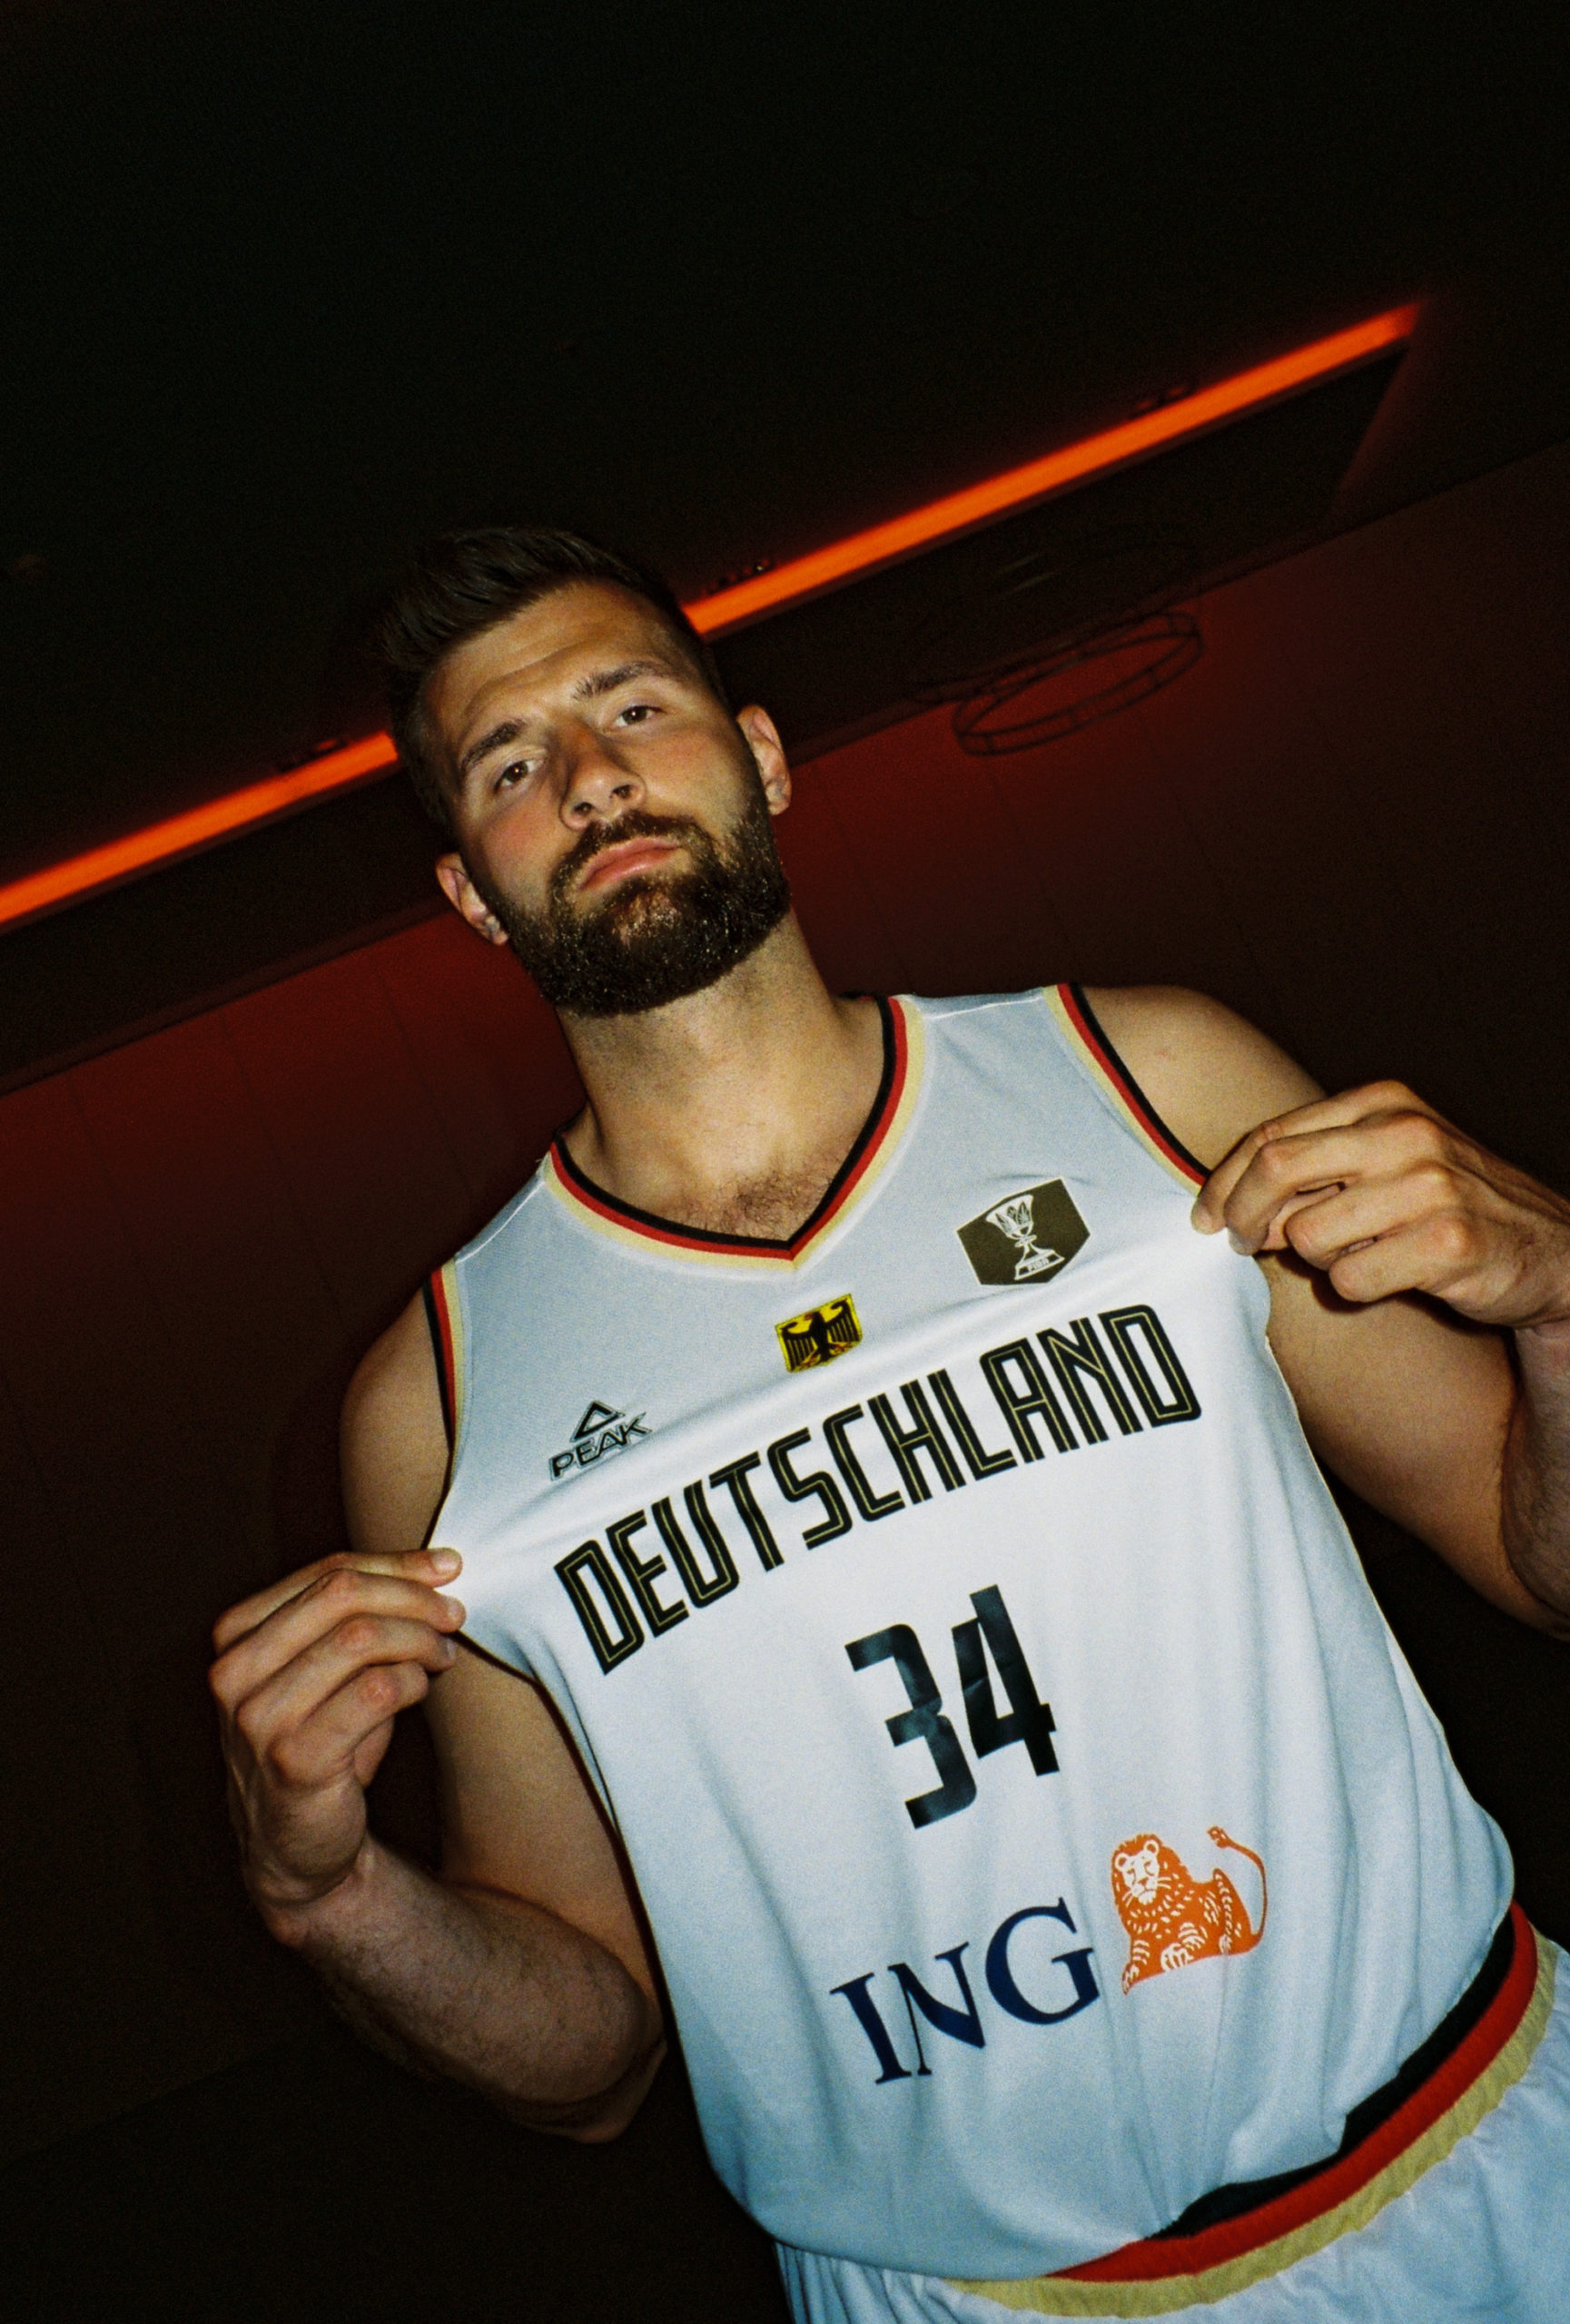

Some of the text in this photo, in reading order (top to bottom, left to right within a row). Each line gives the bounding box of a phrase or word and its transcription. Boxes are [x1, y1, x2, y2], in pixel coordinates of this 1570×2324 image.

[548, 1412, 652, 1481] PEAK
[553, 1305, 1201, 1675] DEUTSCHLAND
[844, 1584, 1060, 1829] 34
[829, 1896, 1101, 2084] ING
